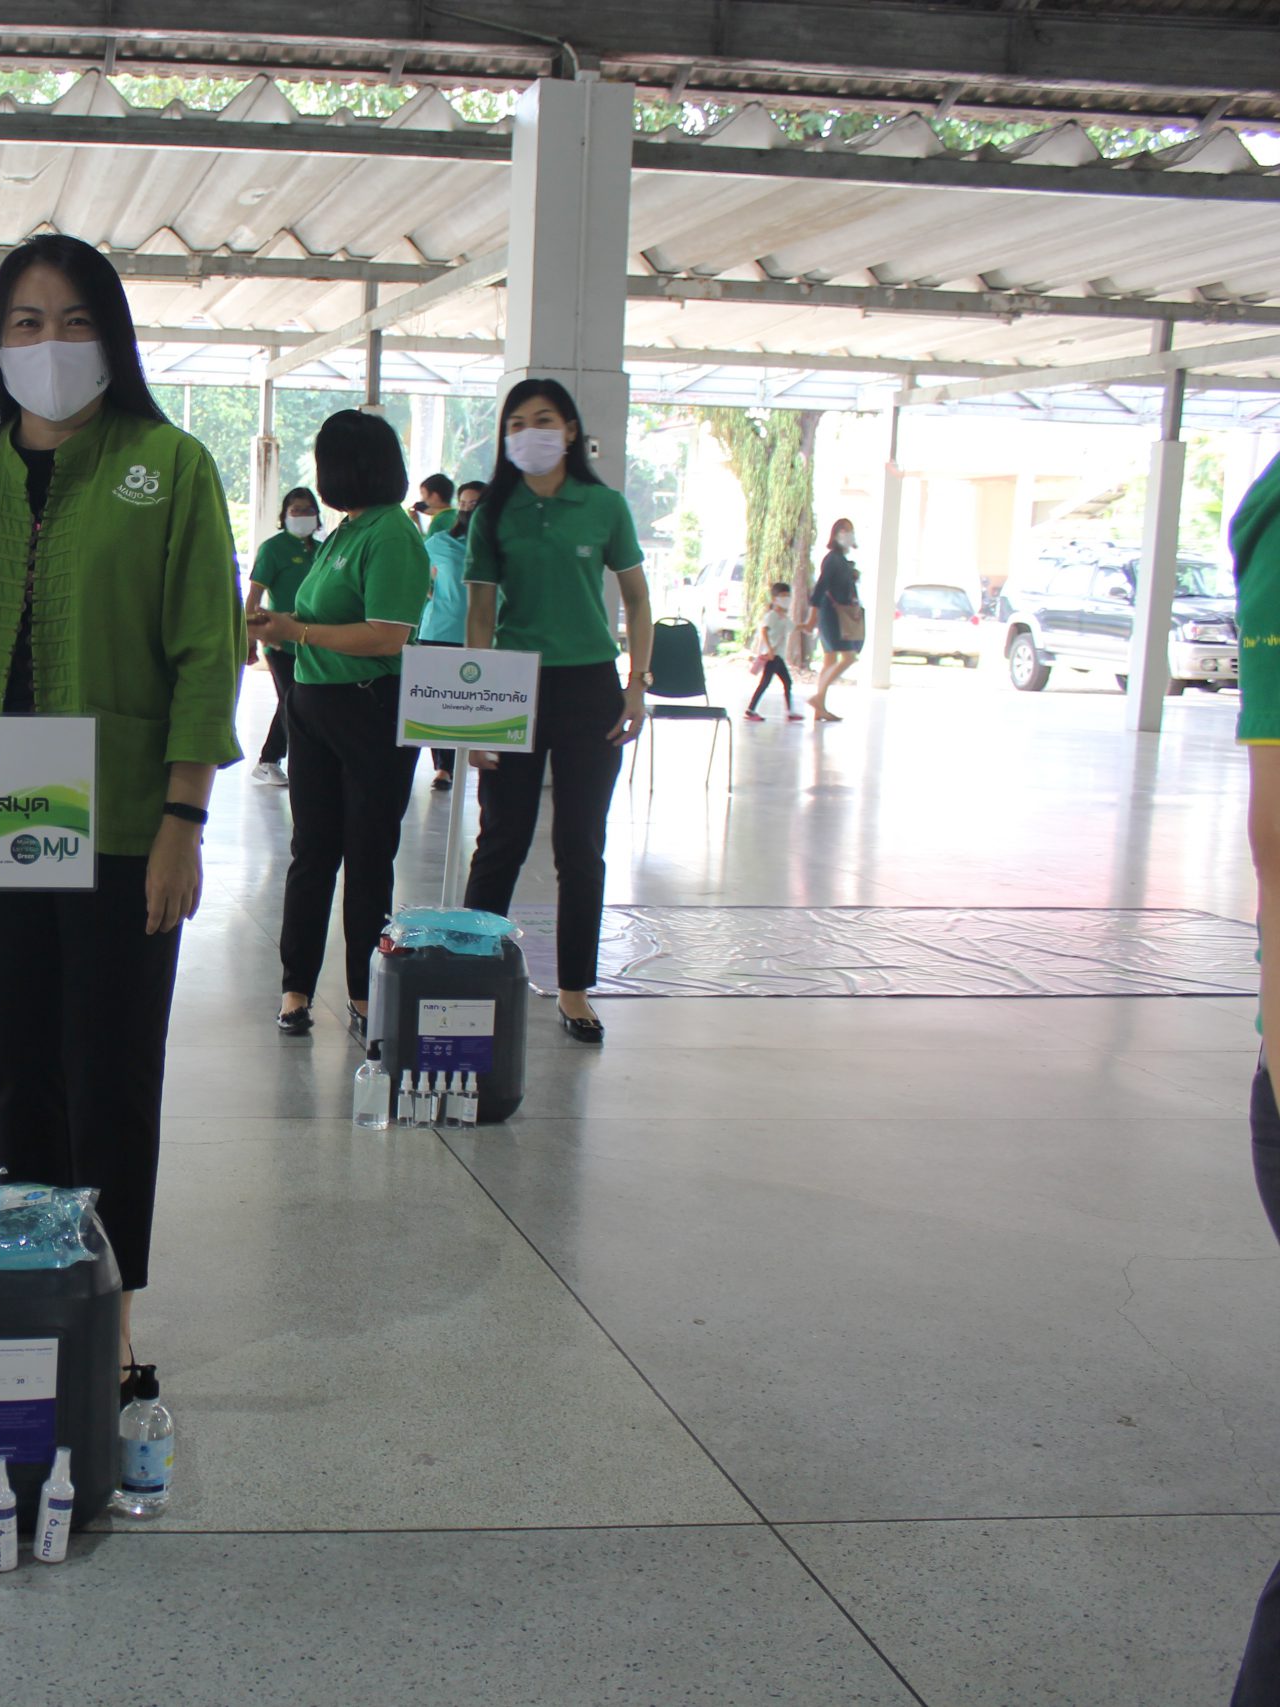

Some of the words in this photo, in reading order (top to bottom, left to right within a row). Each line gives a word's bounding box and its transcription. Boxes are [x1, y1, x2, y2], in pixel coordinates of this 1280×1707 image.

[410, 684, 528, 703] สำนักงานมหาวิทยาลัย
[442, 703, 473, 712] University
[507, 729, 524, 741] MJU
[43, 836, 79, 863] MJU
